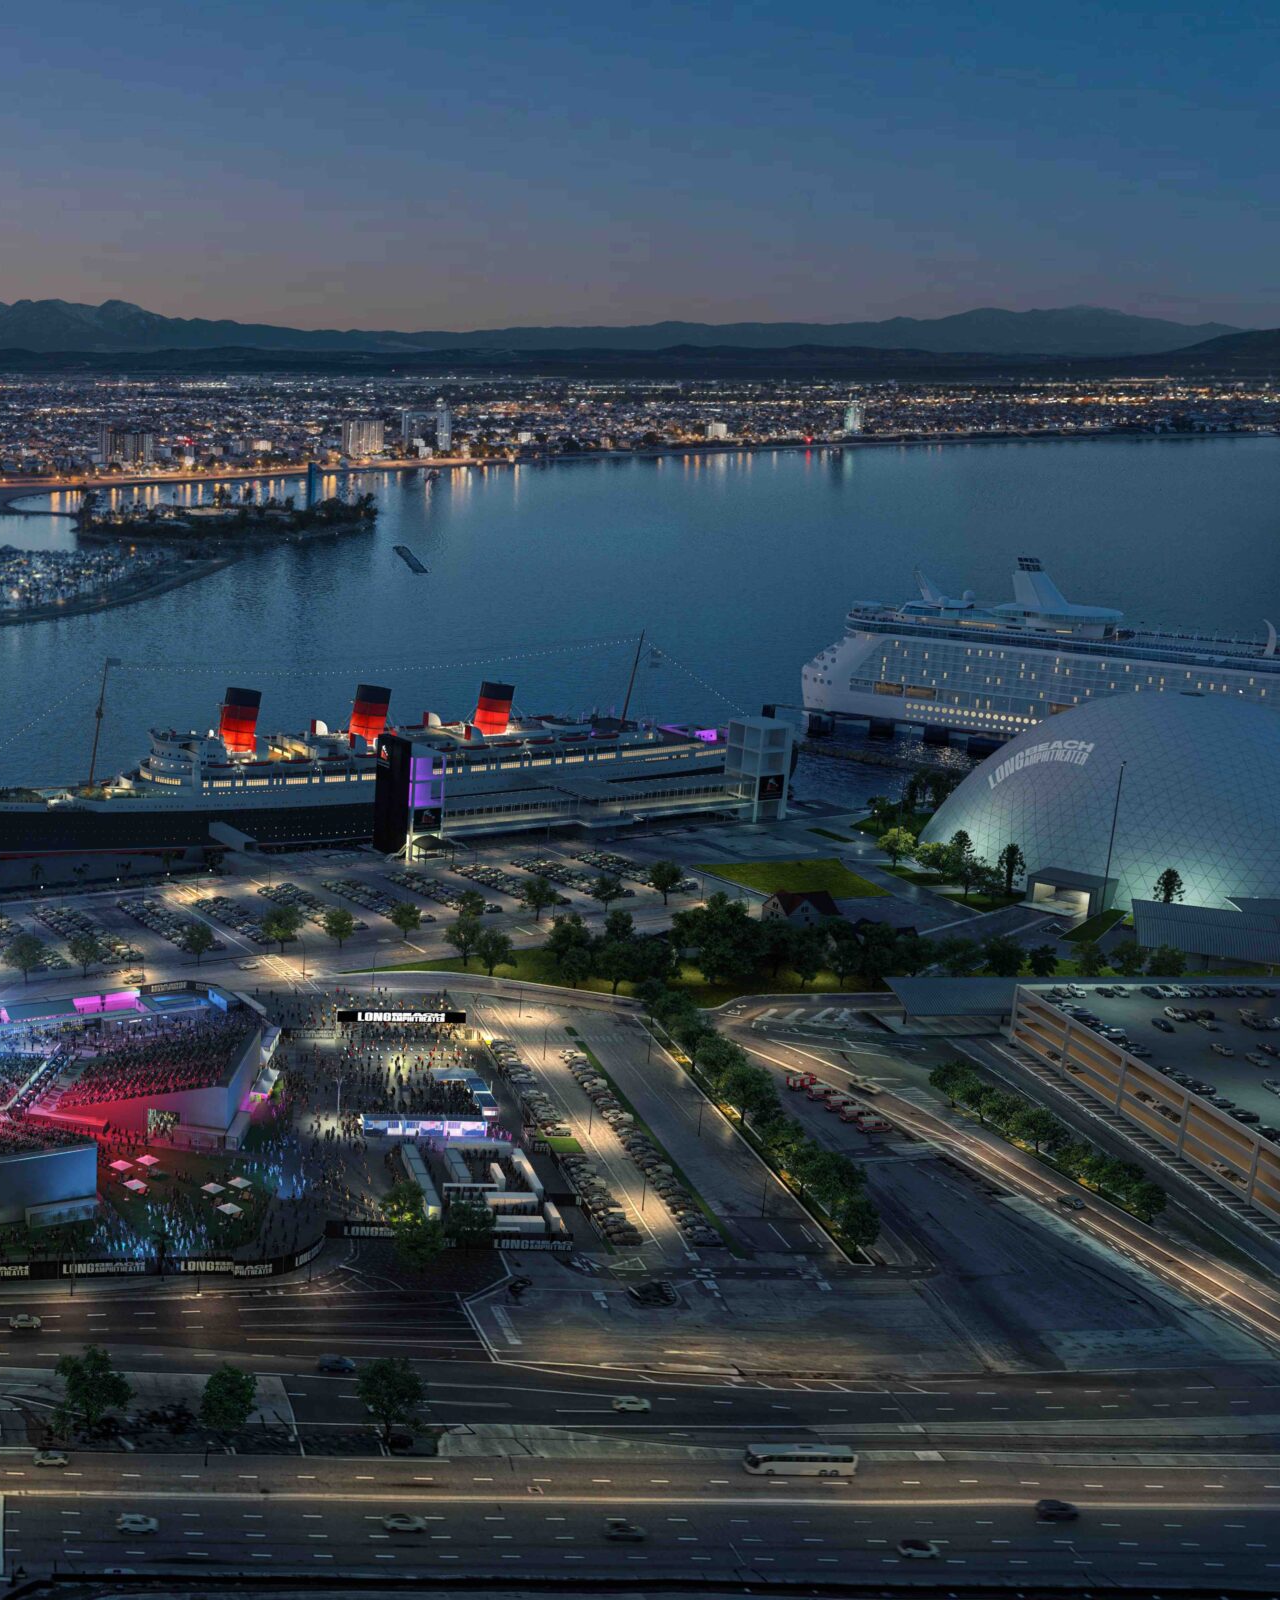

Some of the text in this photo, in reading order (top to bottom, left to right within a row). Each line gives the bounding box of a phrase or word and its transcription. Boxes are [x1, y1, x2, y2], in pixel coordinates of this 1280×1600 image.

[1023, 749, 1089, 766] AMPHITHEATER
[988, 740, 1095, 790] LONG BEACH
[493, 1239, 529, 1249] LONG
[180, 1261, 215, 1272] LONG
